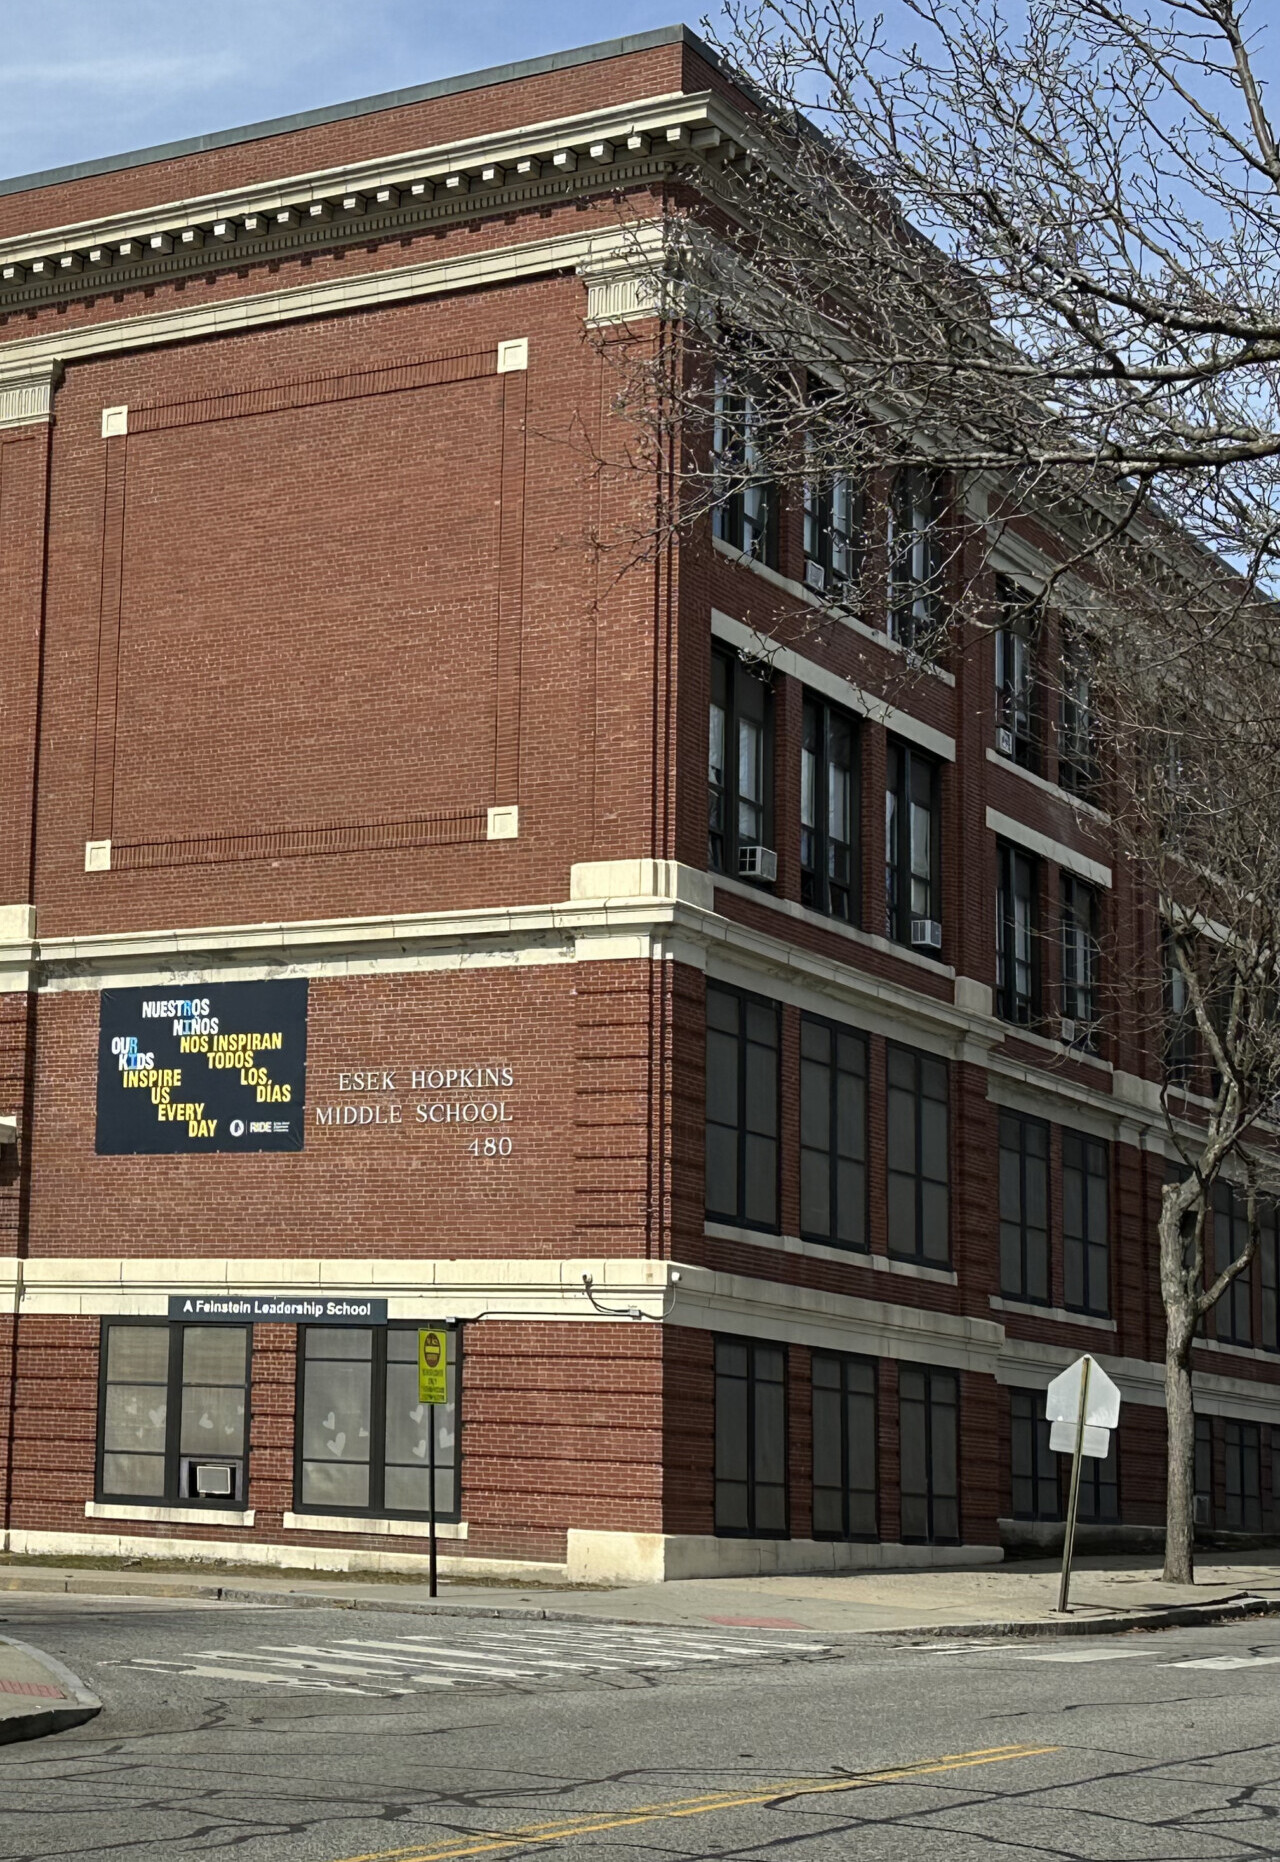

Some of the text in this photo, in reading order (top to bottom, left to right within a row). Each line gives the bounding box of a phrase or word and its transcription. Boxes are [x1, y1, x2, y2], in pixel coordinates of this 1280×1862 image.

[142, 998, 210, 1018] NUESTROS
[173, 1015, 219, 1036] NIÑOS
[111, 1036, 138, 1055] OUR
[180, 1032, 282, 1053] NOS INSPIRAN
[118, 1052, 155, 1071] KIDS
[207, 1051, 254, 1069] TODOS
[123, 1069, 182, 1088] INSPIRE
[240, 1067, 268, 1085] LOS
[339, 1067, 514, 1091] ESEK HOPKINS
[151, 1086, 170, 1104] US
[256, 1078, 292, 1103] DÍAS
[158, 1103, 205, 1121] EVERY
[316, 1101, 513, 1125] MIDDLE SCHOOL
[188, 1119, 218, 1138] DAY
[468, 1136, 512, 1157] 480
[183, 1300, 371, 1317] A Feinstein Leadership School
